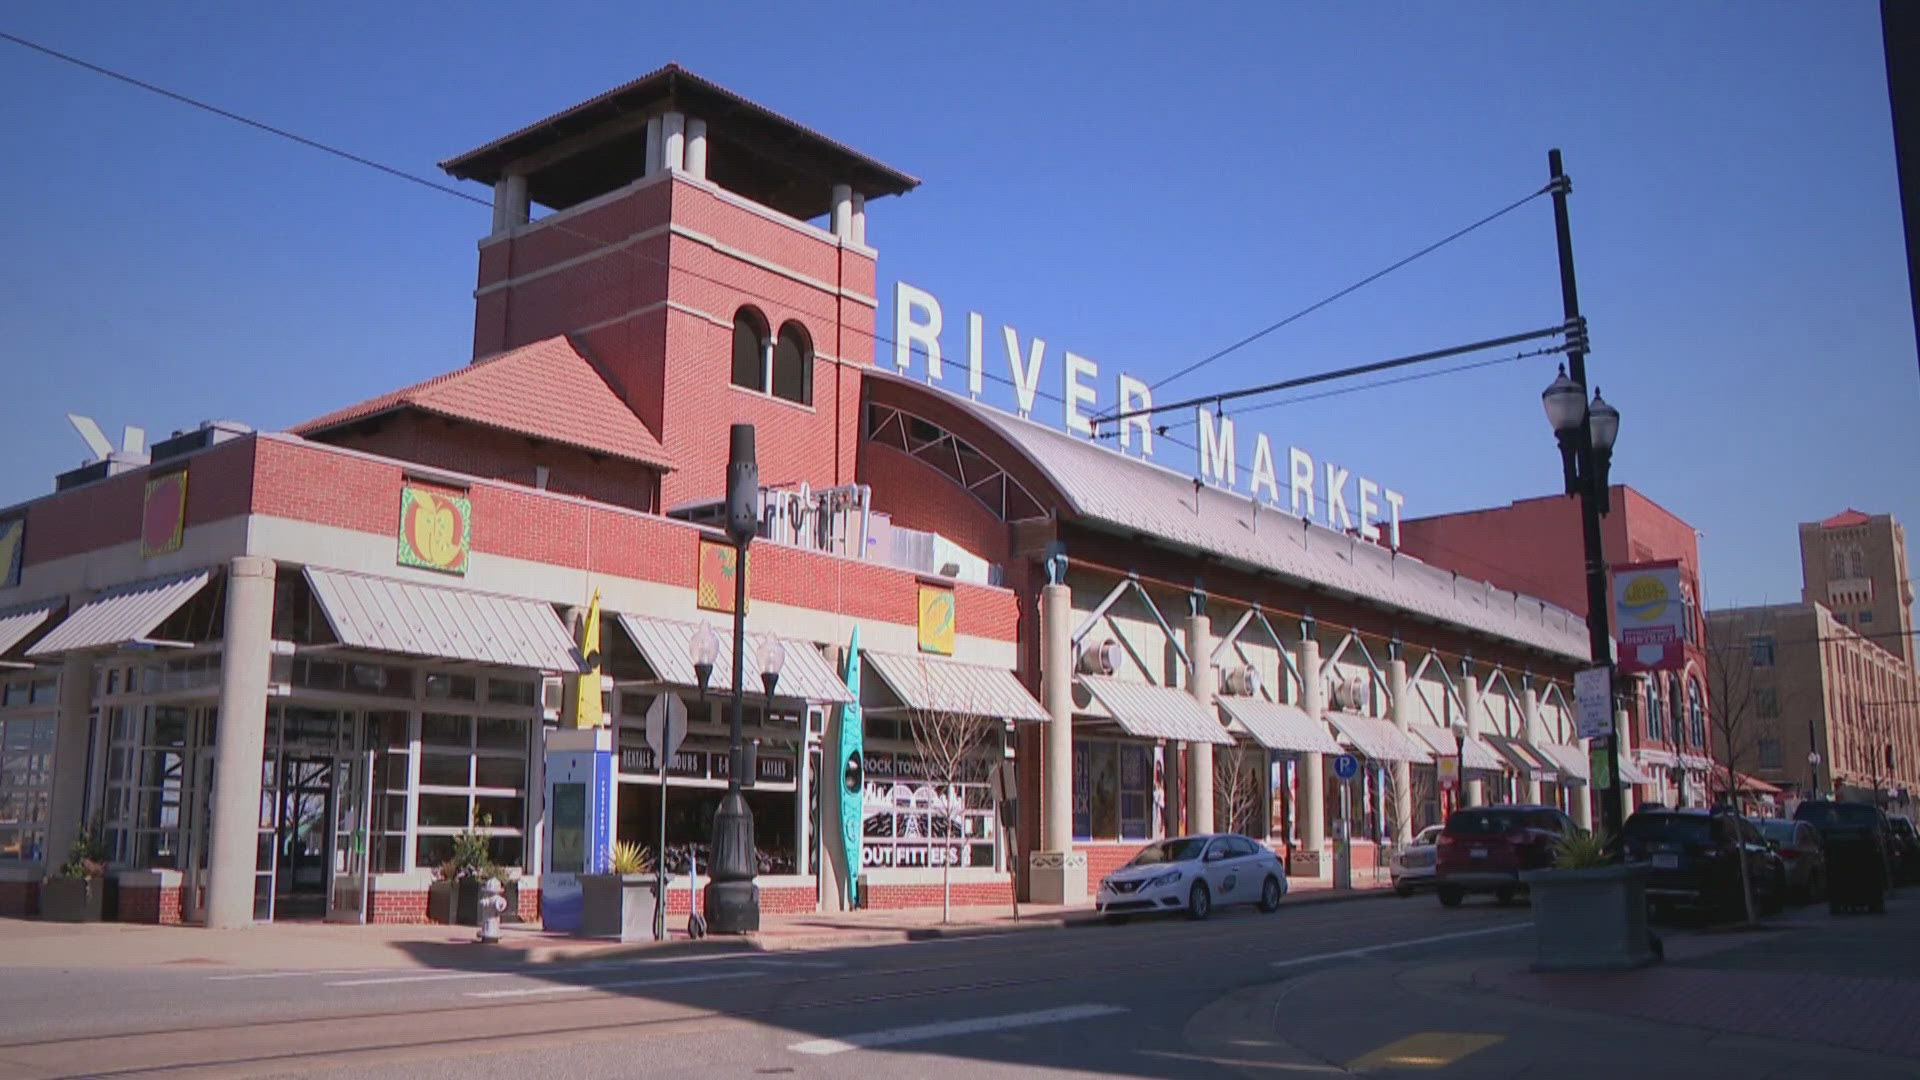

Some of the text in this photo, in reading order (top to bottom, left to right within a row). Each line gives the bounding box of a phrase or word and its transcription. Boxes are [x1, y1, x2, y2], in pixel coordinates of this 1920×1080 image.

[893, 281, 1403, 549] RIVER MARKET
[622, 749, 651, 769] RENTALS
[762, 759, 787, 778] KAYAKS
[863, 758, 892, 774] ROCK
[1340, 757, 1351, 773] P
